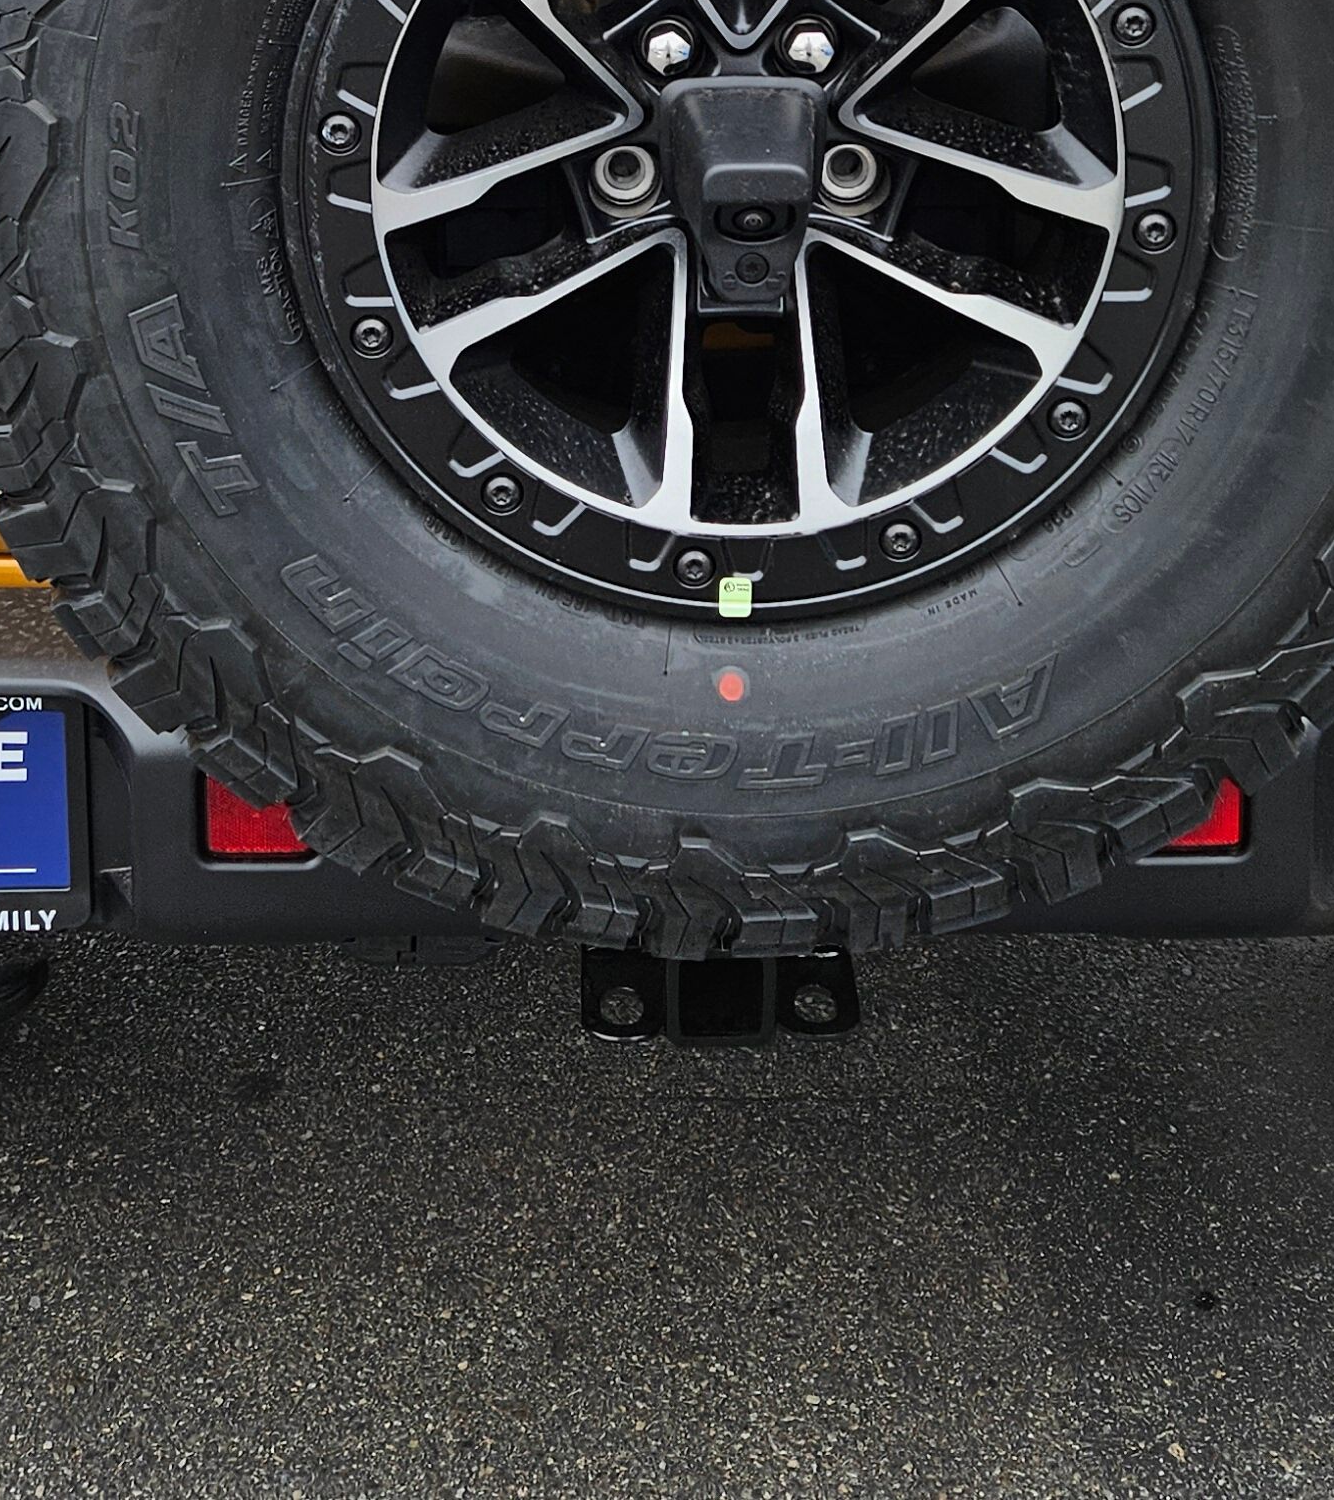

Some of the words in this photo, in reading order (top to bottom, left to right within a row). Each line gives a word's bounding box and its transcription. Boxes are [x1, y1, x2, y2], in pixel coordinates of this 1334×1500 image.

[106, 100, 142, 250] KO2
[266, 244, 304, 336] TRACTION
[127, 293, 261, 518] T/A
[1109, 447, 1180, 527] 113/110S
[925, 603, 941, 617] IN
[943, 586, 978, 610] MADE
[279, 553, 1058, 790] All-Terrain
